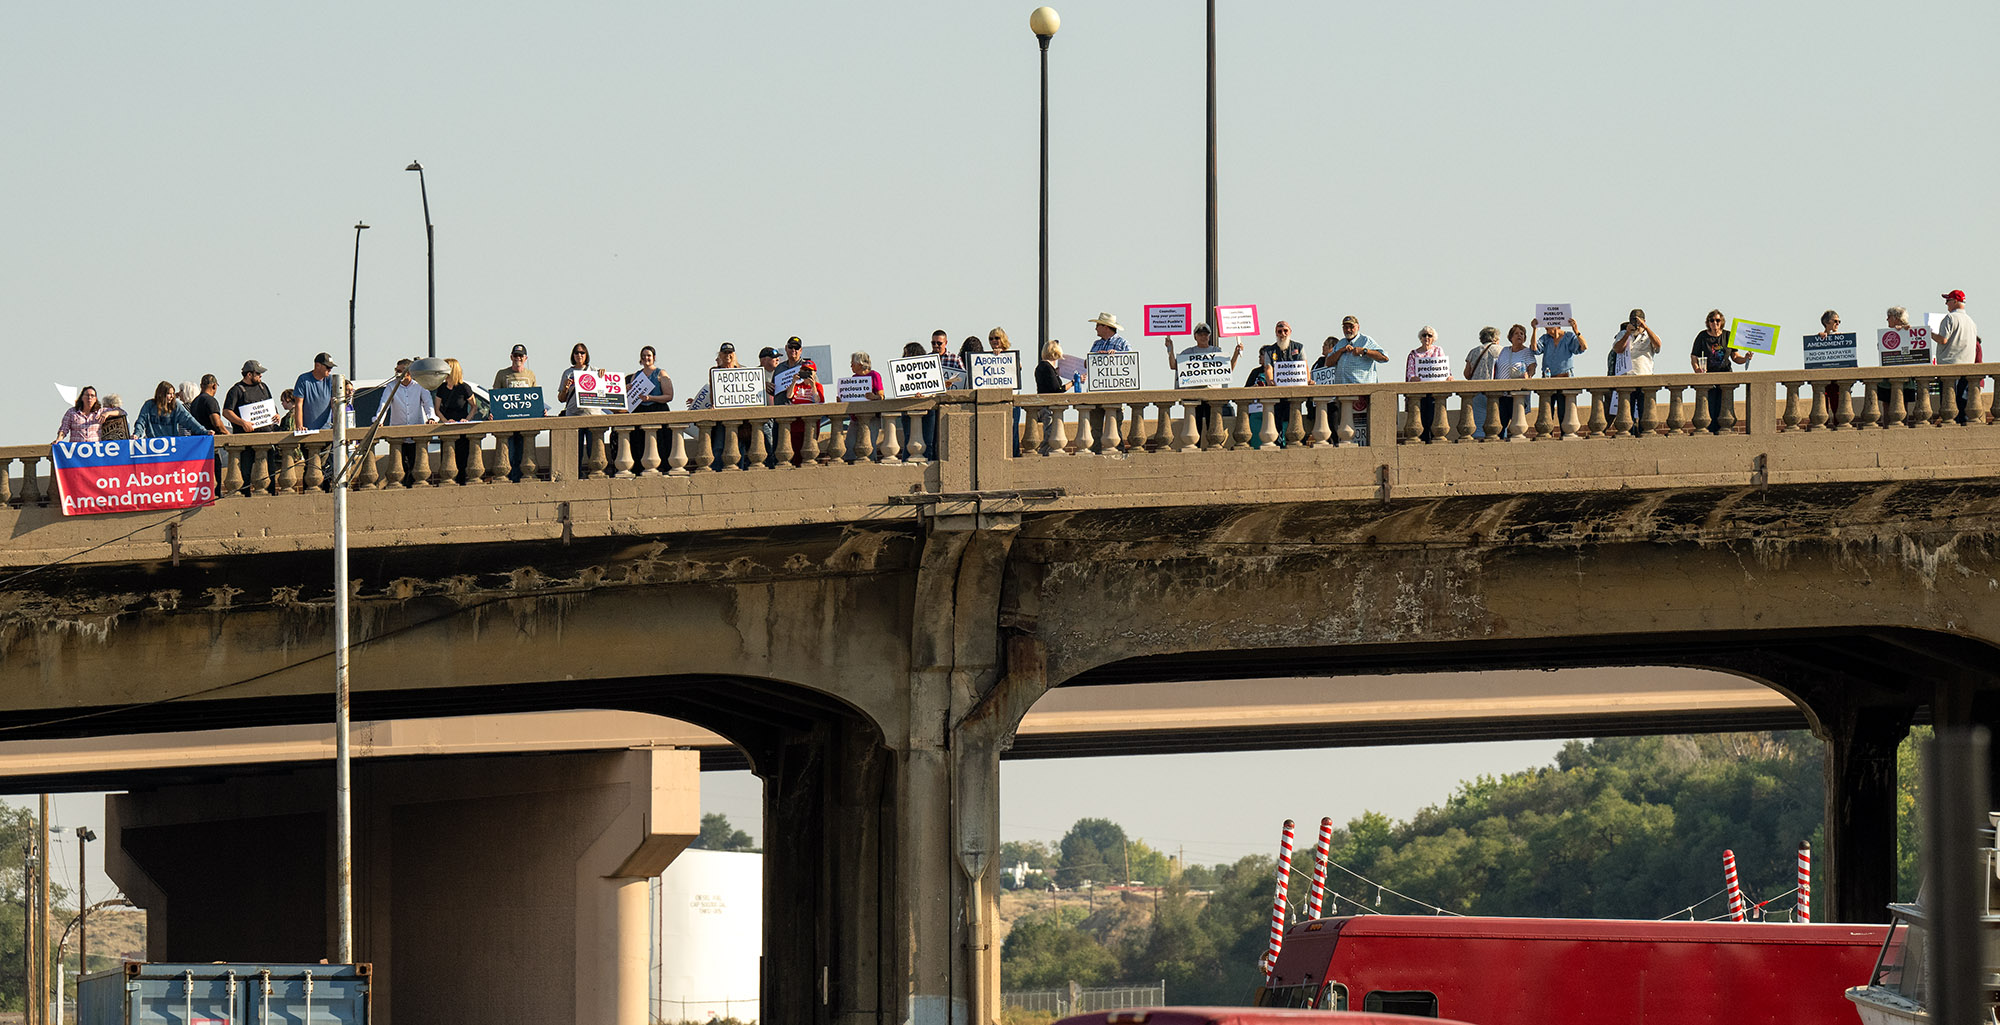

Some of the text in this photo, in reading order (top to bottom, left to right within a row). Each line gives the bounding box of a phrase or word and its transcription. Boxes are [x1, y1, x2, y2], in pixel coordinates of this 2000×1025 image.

[1909, 328, 1926, 337] NO
[1911, 340, 1926, 349] 79
[1092, 355, 1135, 366] ABORTION
[896, 360, 936, 373] ADOPTION
[1098, 367, 1130, 376] KILLS
[717, 372, 760, 382] ABORTION
[907, 372, 927, 380] NOT
[1180, 368, 1231, 377] ABORTION
[604, 374, 621, 382] NO
[1092, 378, 1136, 388] CHILDREN
[723, 383, 755, 392] KILLS
[900, 380, 939, 392] ABORTION
[718, 394, 761, 404] CHILDREN
[59, 437, 176, 459] Vote NO!
[96, 469, 210, 489] on Abortion
[64, 486, 212, 508] Amendment 79
